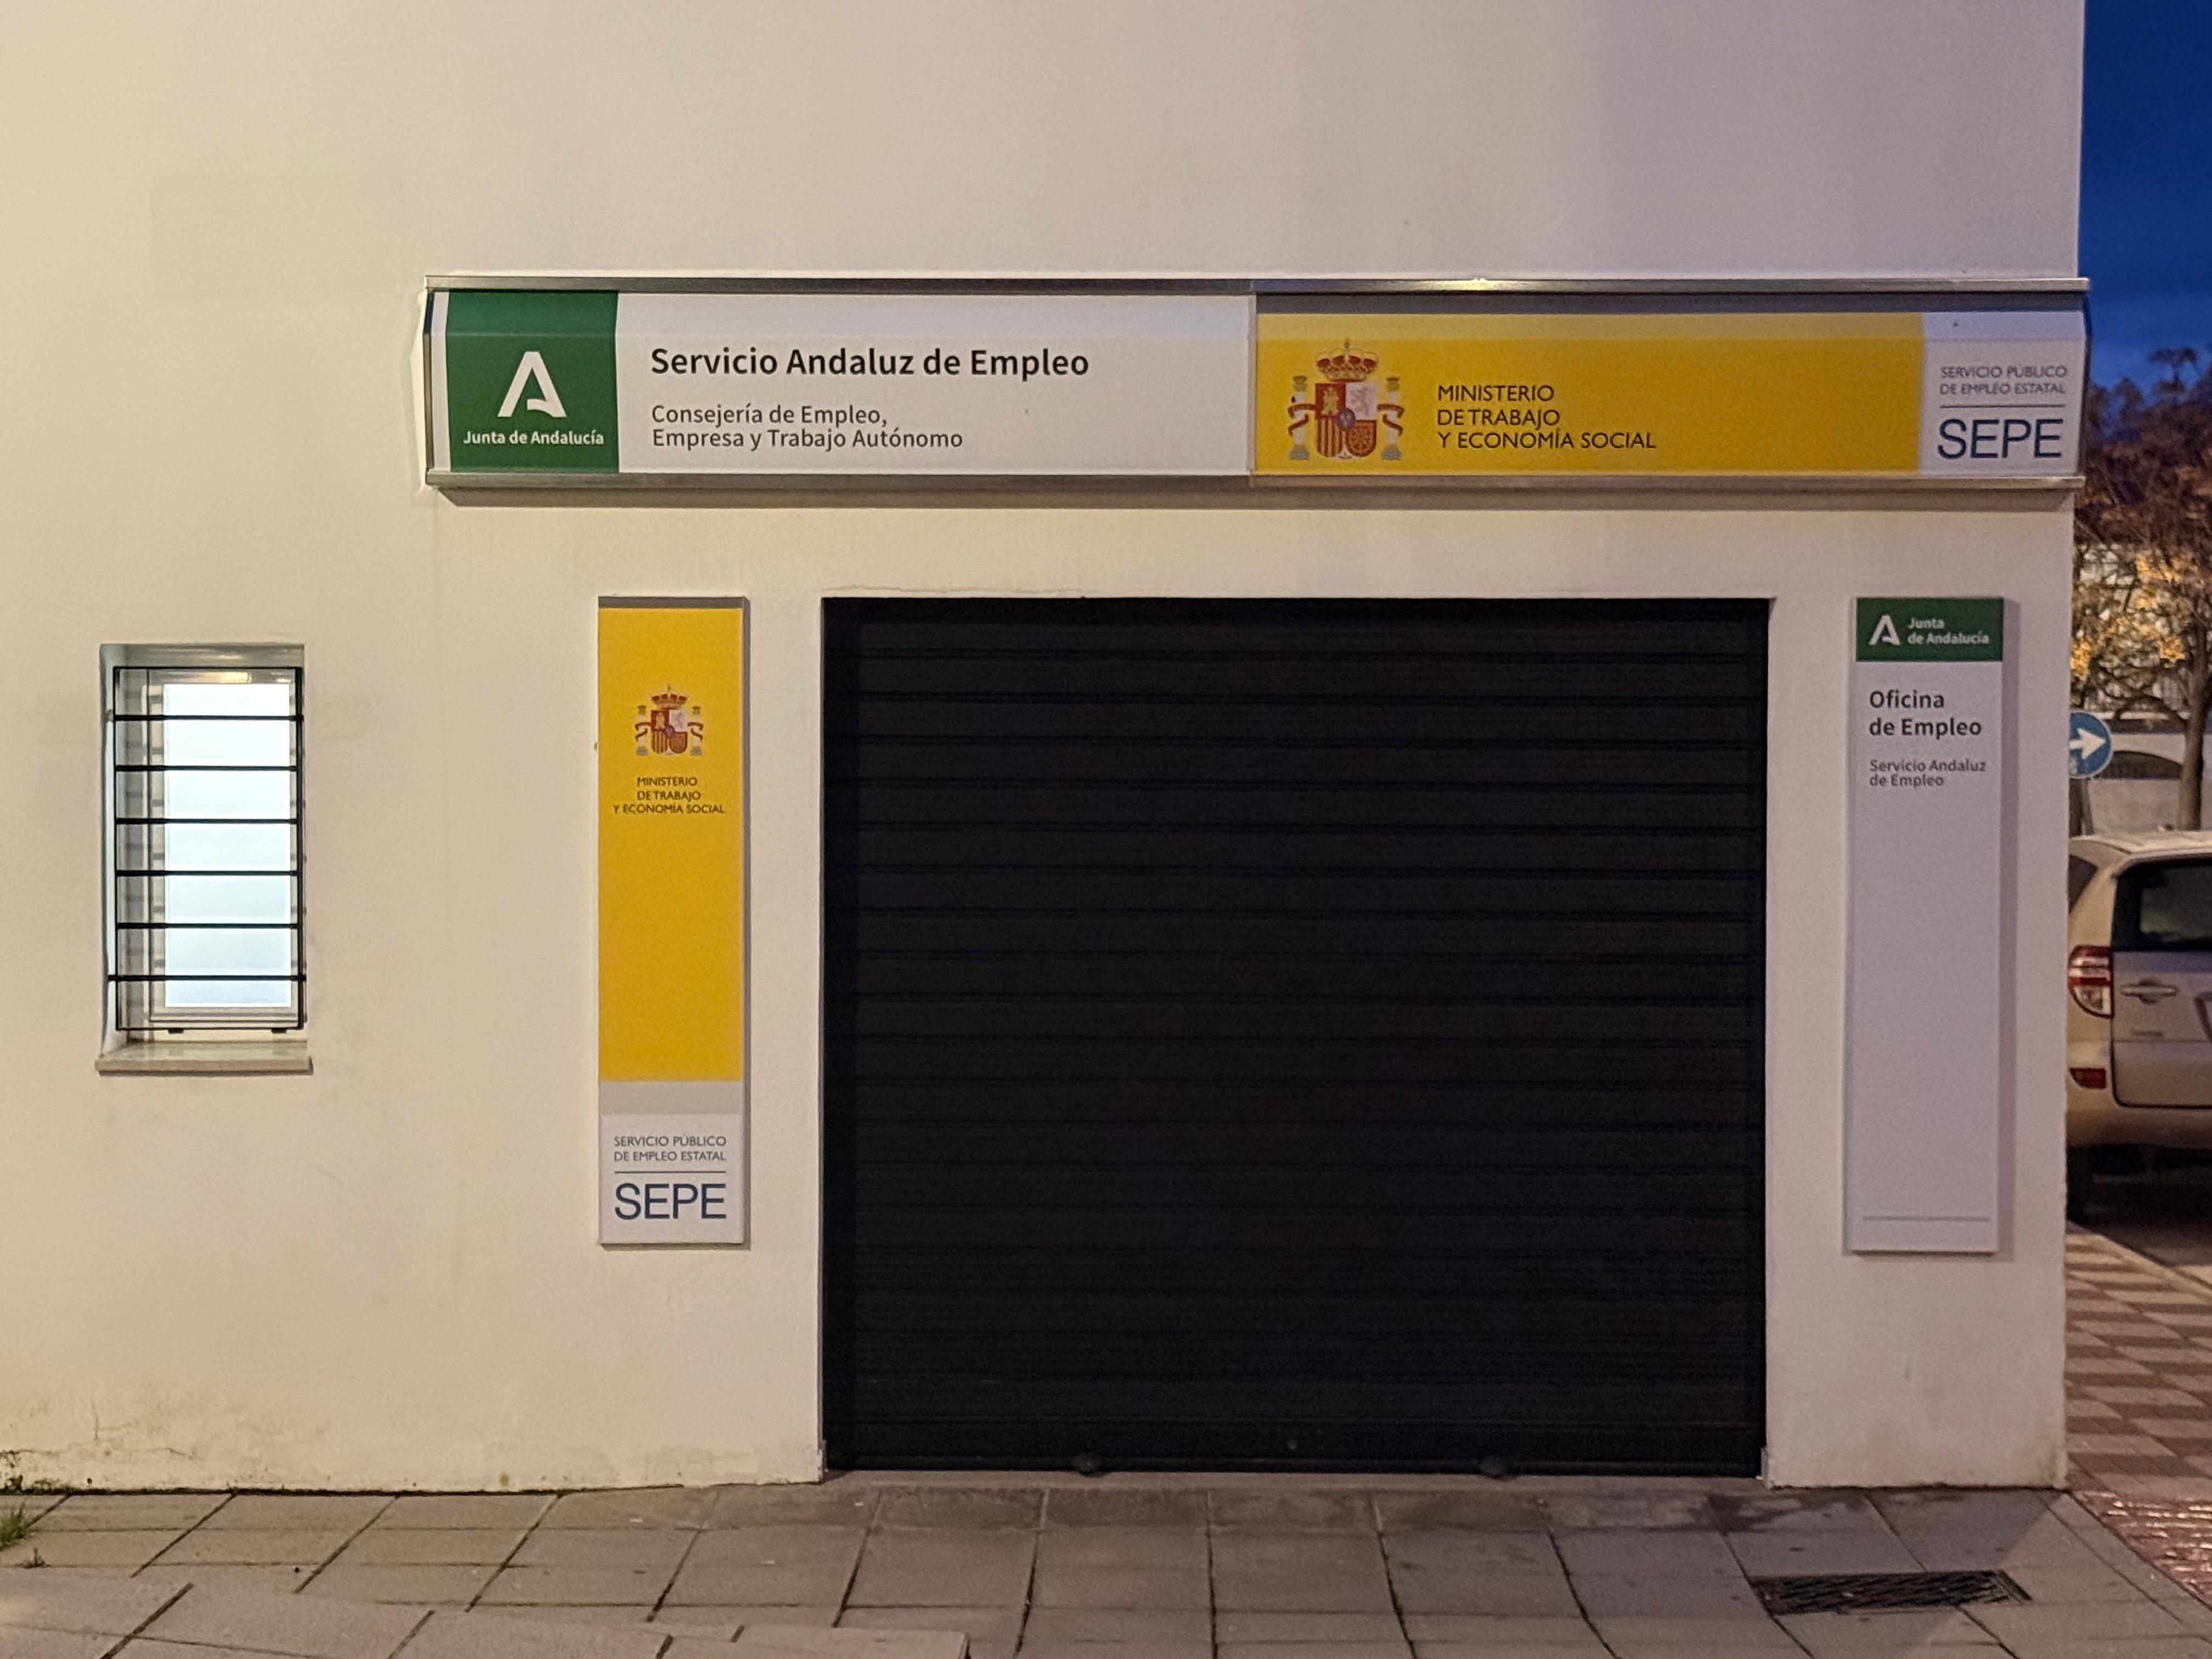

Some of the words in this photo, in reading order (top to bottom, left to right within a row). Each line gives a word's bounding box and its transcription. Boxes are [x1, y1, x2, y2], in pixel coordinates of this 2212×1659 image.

[651, 347, 778, 375] Servicio
[786, 347, 915, 375] Andaluz
[923, 347, 961, 375] de
[971, 347, 1089, 382] Empleo
[1940, 366, 2002, 379] SERVICIO
[1437, 385, 1555, 402] MINISTERIO
[1939, 383, 1956, 395] DE
[1961, 383, 2011, 395] EMPLEO
[2014, 383, 2065, 394] ESTATAL
[652, 403, 763, 428] Consejería
[769, 404, 795, 424] de
[801, 404, 887, 428] Empleo,
[1437, 409, 1464, 426] DE
[1467, 408, 1560, 431] TRABAJO
[463, 431, 506, 445] Junta
[509, 430, 528, 445] de
[531, 429, 605, 445] Andalucía
[653, 428, 744, 452] Empresa
[749, 433, 762, 452] y
[767, 428, 846, 453] Trabajo
[852, 427, 963, 448] Autónomo
[1437, 432, 1452, 449] Y
[1457, 428, 1574, 449] ECONOMÍA
[1581, 432, 1656, 449] SOCIAL
[1937, 419, 2064, 460] SEPE
[1908, 618, 1945, 630] Junta
[1908, 633, 1924, 645] de
[1926, 631, 1990, 645] Andalucía
[1869, 689, 1945, 709] Oficina
[1869, 717, 1895, 736] de
[1901, 716, 1982, 741] Empleo
[1870, 759, 1926, 772] Servicio
[1929, 759, 1987, 772] Andaluz
[636, 776, 698, 786] MINISTERIO
[1869, 774, 1887, 787] de
[1891, 774, 1944, 789] Empleo
[636, 791, 651, 800] DE
[653, 791, 701, 802] TRABAJO
[613, 804, 620, 814] Y
[686, 804, 726, 814] SOCIAL
[614, 1136, 669, 1147] SERVICIO
[673, 1133, 727, 1147] PÚBLICO
[614, 1151, 629, 1162] DE
[633, 1151, 678, 1162] EMPLEO
[680, 1151, 726, 1162] ESTATAL
[614, 1183, 727, 1220] SEPE
